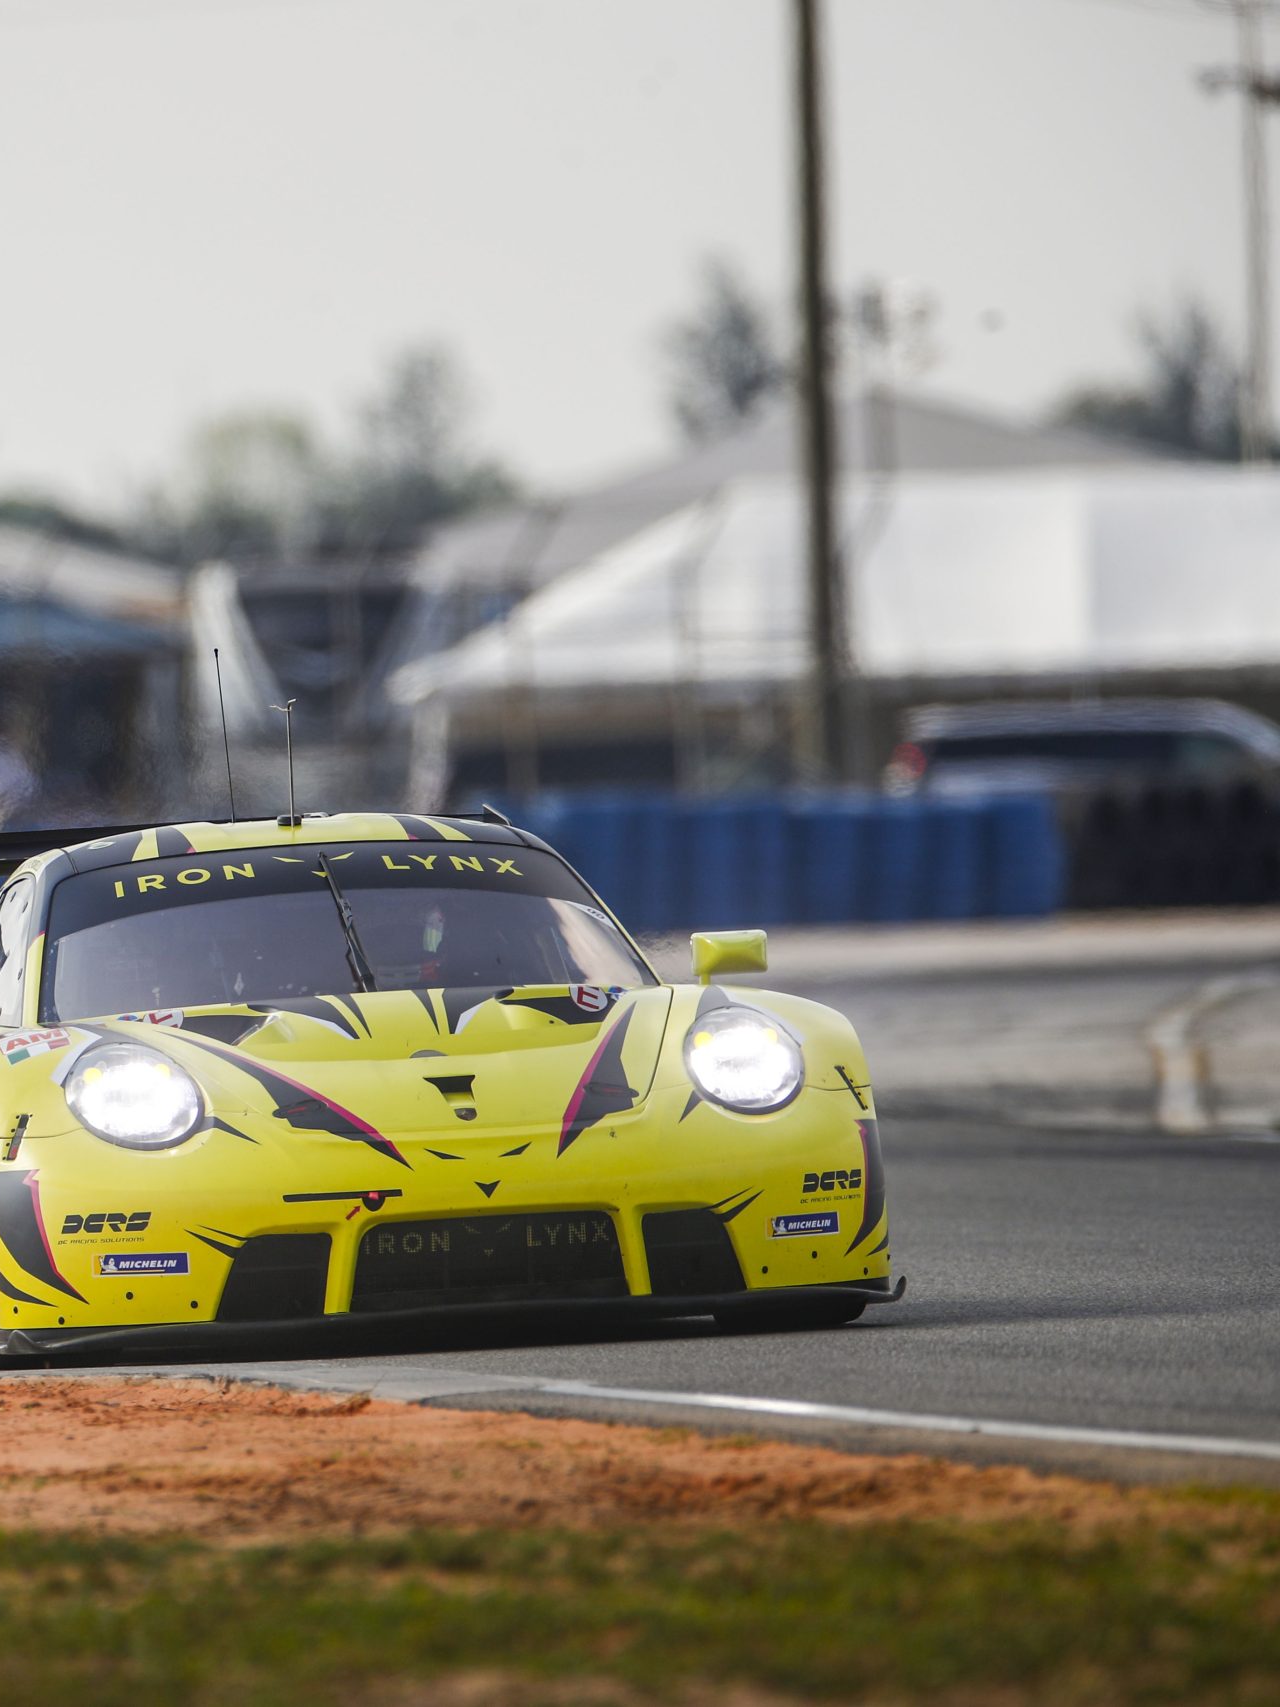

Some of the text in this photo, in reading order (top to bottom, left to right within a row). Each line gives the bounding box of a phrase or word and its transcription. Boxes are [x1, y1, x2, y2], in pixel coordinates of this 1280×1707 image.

[115, 855, 524, 898] IRON LYNX
[6, 1028, 63, 1051] AM
[788, 1219, 831, 1230] MICHELIN
[100, 1236, 145, 1244] SOLUTIONS
[363, 1219, 610, 1255] IRON LYNX
[118, 1259, 178, 1270] MICHELIN
